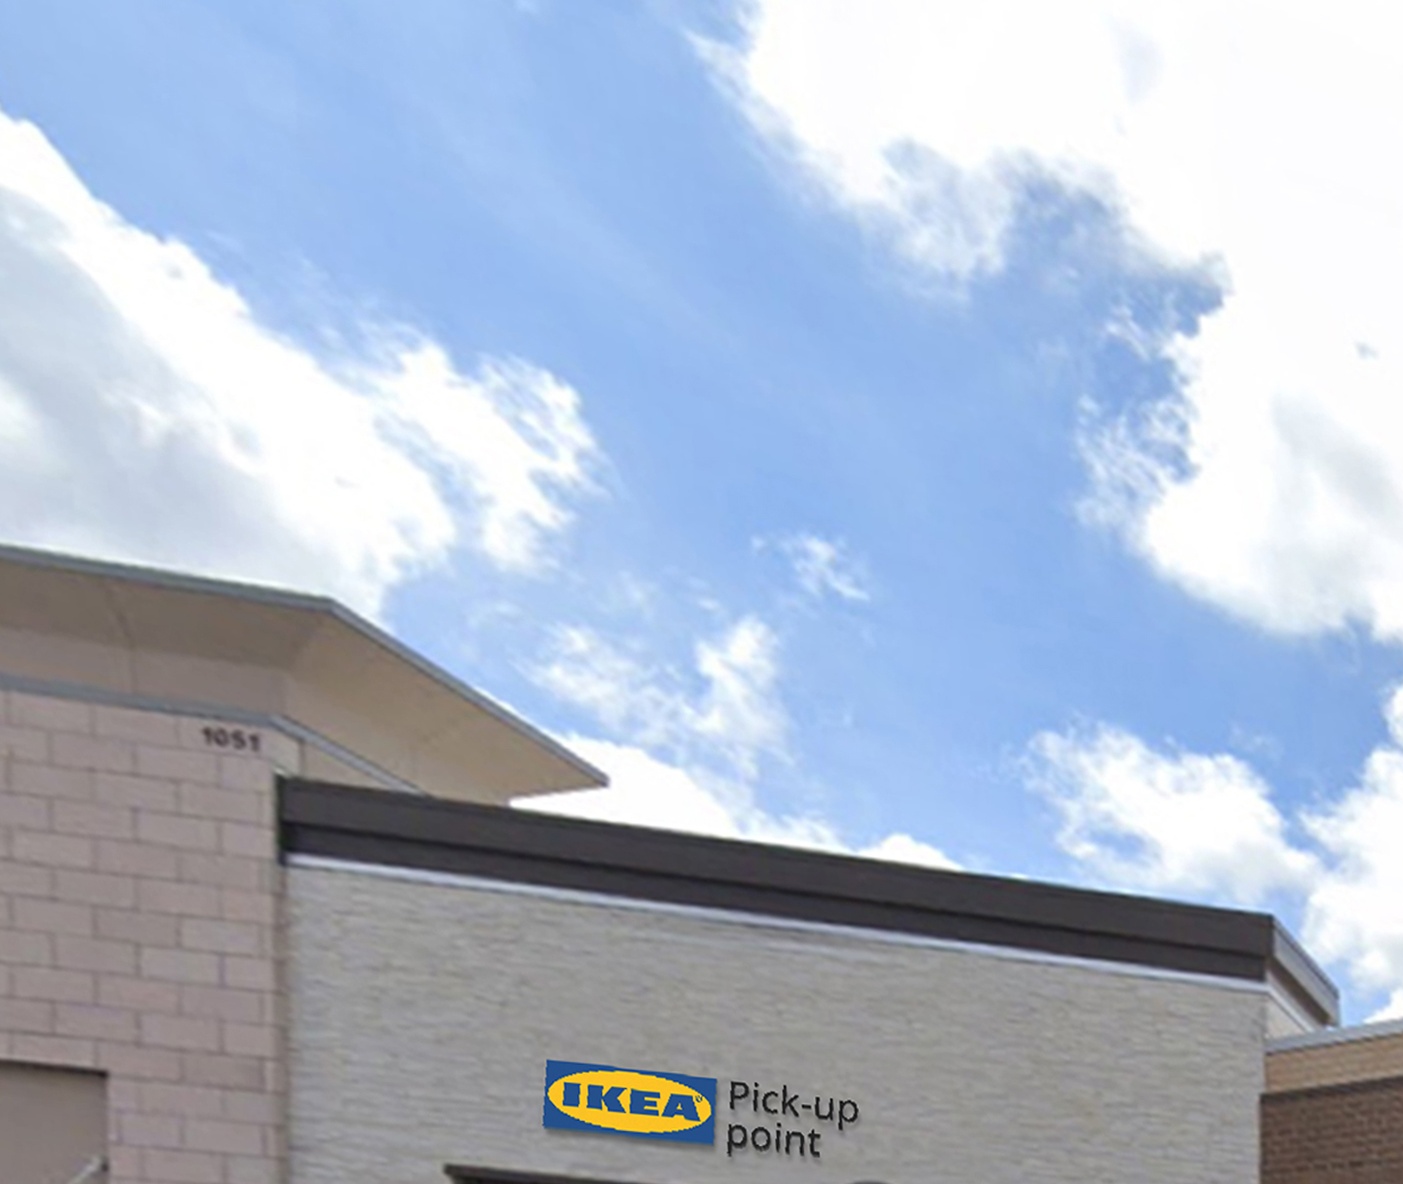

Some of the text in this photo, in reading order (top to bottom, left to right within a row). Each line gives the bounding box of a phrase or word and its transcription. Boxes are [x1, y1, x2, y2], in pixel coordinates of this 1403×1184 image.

[202, 726, 260, 752] 1051
[562, 1082, 703, 1122] IKEA
[729, 1081, 859, 1130] Pick-up
[727, 1122, 821, 1157] point
